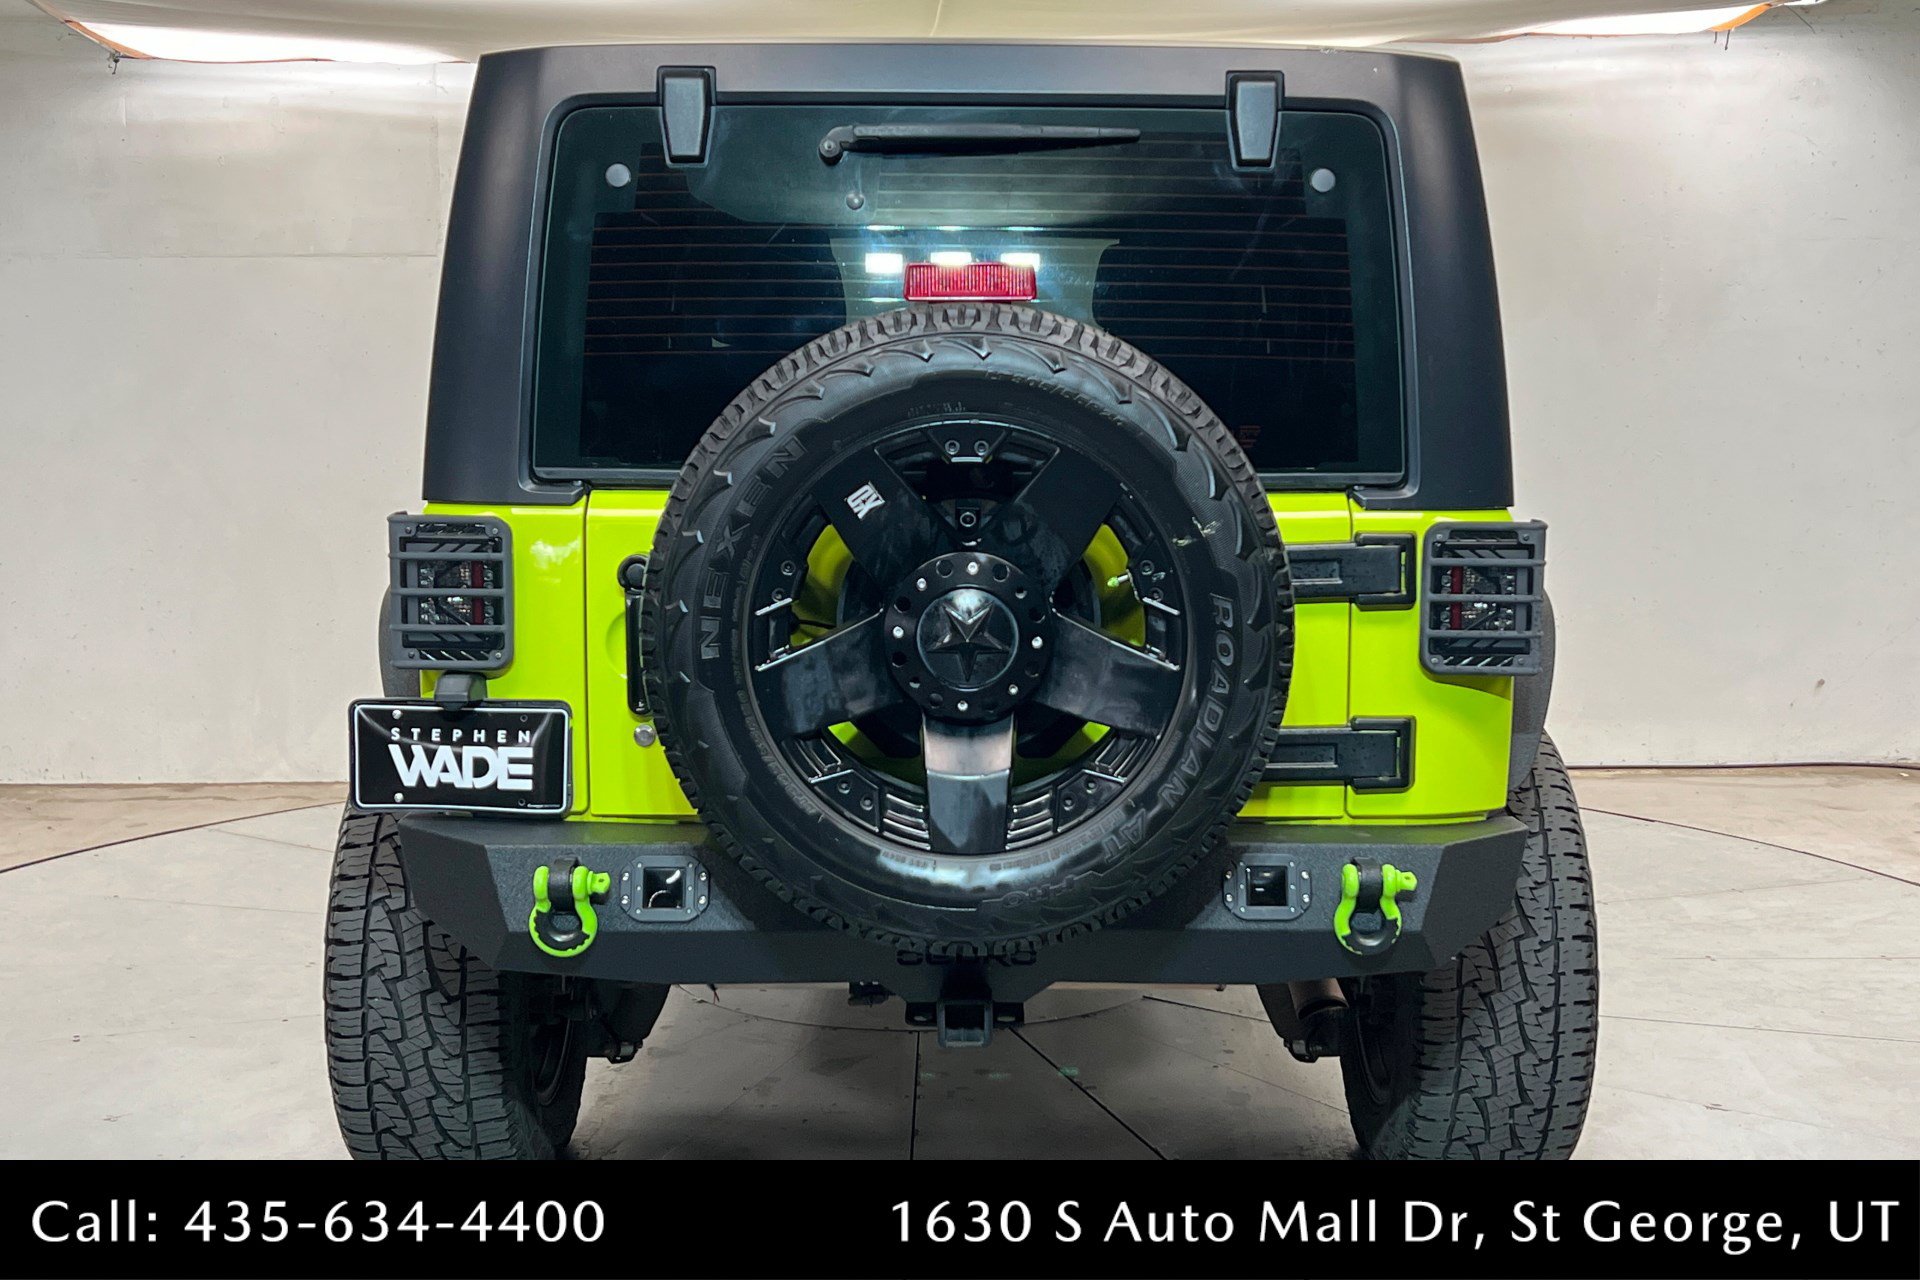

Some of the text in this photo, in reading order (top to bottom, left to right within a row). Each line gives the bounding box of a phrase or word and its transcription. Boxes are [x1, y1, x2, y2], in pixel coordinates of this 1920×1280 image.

[700, 435, 806, 660] NEXEN
[390, 727, 532, 743] STEPHEN
[1157, 592, 1235, 808] ROADIAN
[387, 743, 534, 791] WADE
